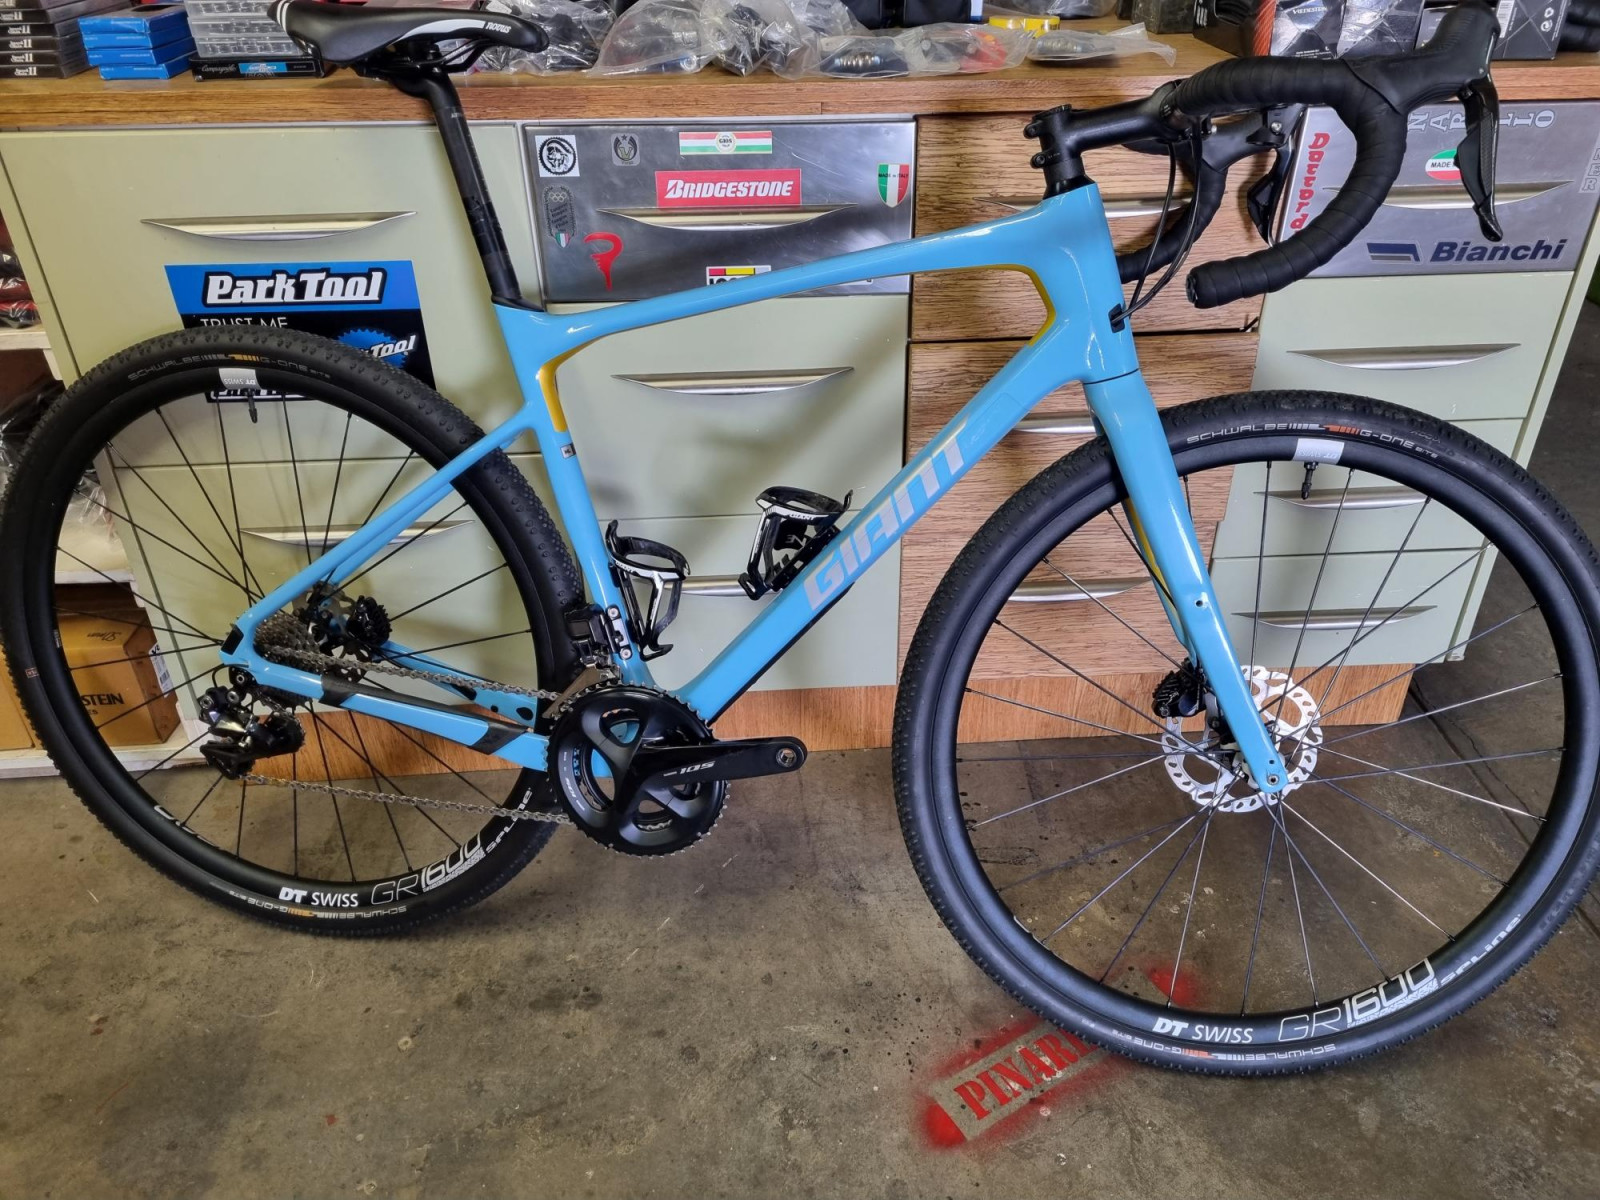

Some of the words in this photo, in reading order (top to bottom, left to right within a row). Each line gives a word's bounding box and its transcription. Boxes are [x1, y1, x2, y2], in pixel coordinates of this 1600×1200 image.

[664, 178, 794, 201] BRIDGESTONE
[1290, 132, 1331, 234] Daccord
[1429, 238, 1569, 263] Bianchi
[127, 353, 202, 382] SCHWALBE
[1186, 423, 1289, 445] SCHWALBE
[1358, 428, 1416, 450] G-ONE
[803, 421, 967, 612] GIANT
[278, 886, 308, 902] DT
[310, 891, 359, 908] SWISS
[1152, 1016, 1189, 1037] DT
[1191, 1024, 1254, 1044] SWISS
[1242, 1042, 1338, 1062] SCHWALBE
